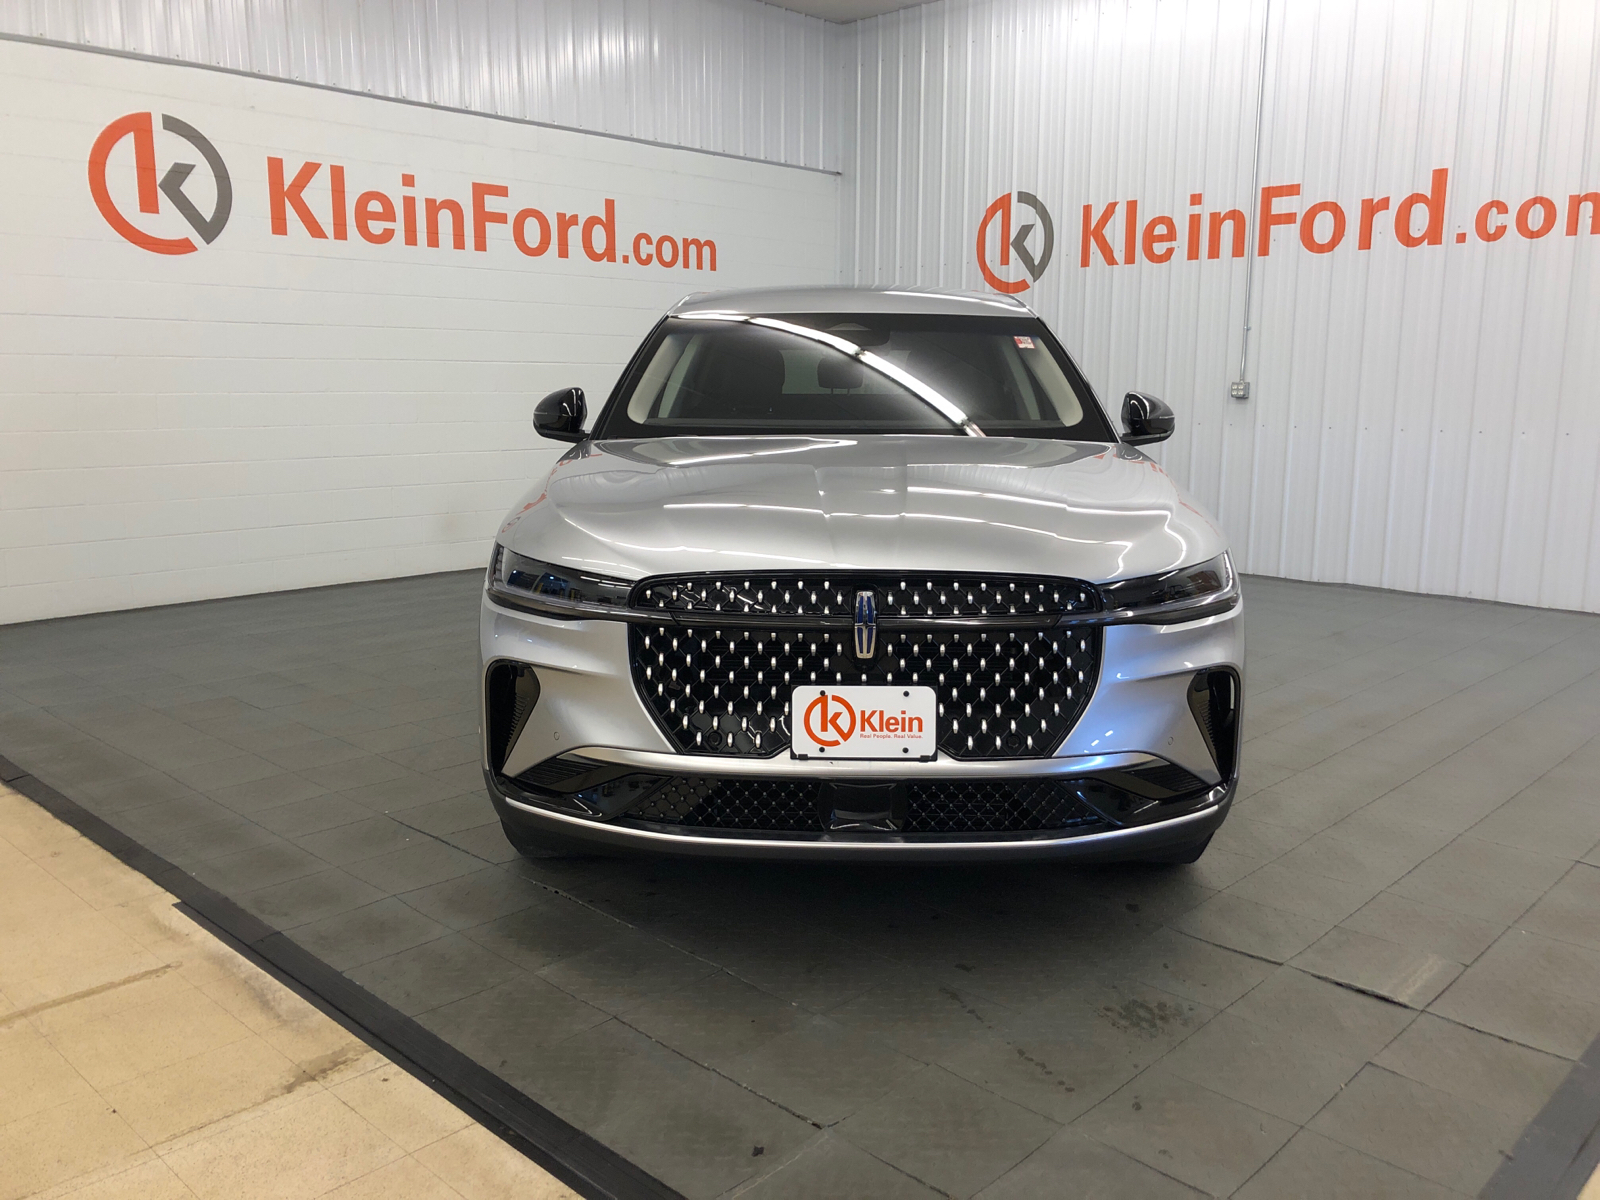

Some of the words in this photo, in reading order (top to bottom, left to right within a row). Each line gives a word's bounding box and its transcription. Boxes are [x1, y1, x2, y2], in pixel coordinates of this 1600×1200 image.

[267, 156, 717, 272] KleinFord.com
[1080, 168, 1600, 268] KleinFord.com
[860, 709, 923, 733] Klein
